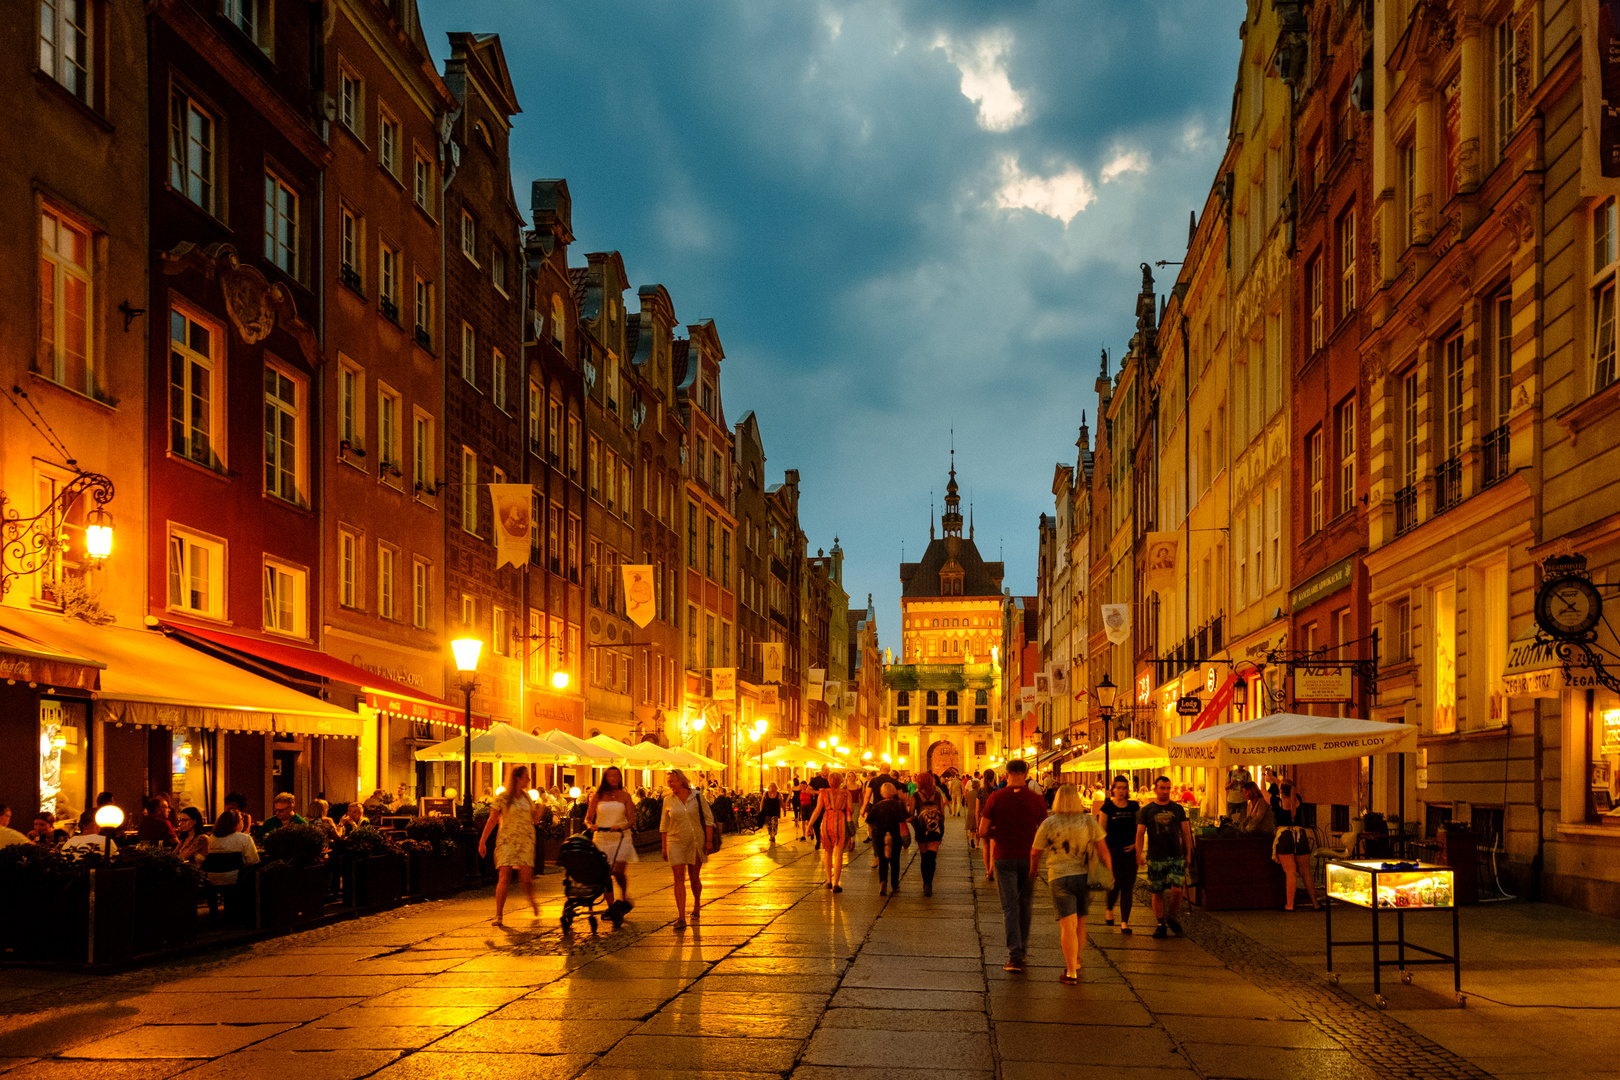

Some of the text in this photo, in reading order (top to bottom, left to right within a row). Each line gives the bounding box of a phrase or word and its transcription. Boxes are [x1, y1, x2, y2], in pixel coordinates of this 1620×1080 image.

[1181, 701, 1197, 709] Lody
[1229, 747, 1240, 755] TU
[1242, 746, 1266, 755] ZJESZ
[1268, 743, 1317, 753] PRAWDZIWE
[1323, 740, 1360, 750] ZDROWE
[1362, 738, 1385, 746] LODY
